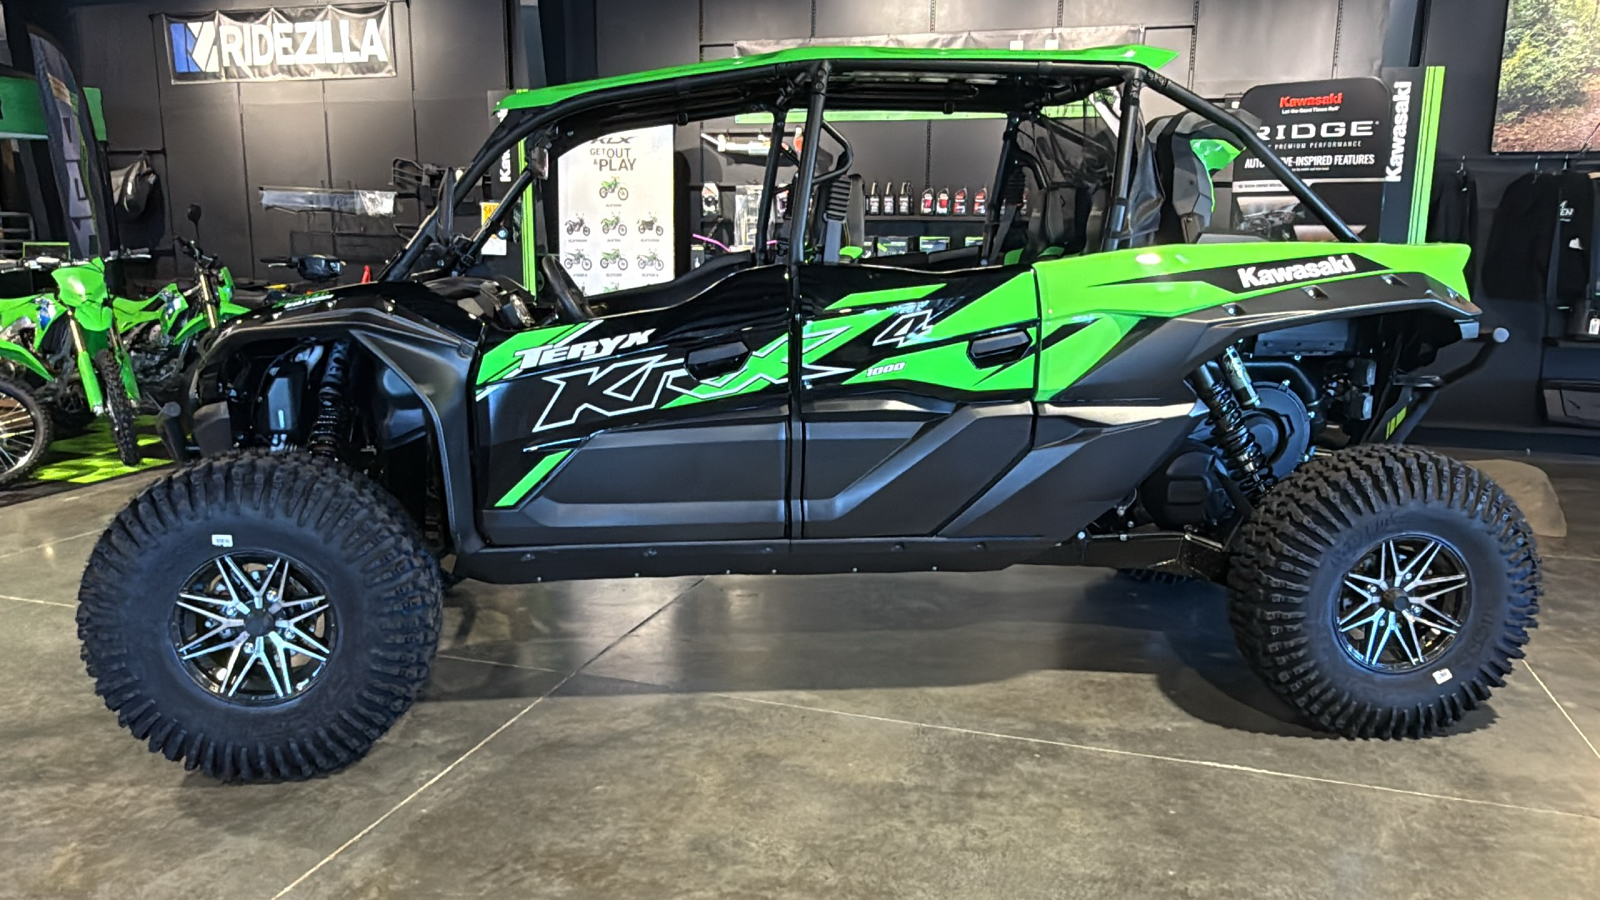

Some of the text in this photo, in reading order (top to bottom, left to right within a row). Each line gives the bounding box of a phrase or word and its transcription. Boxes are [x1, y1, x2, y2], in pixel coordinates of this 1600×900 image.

[219, 18, 389, 68] RIDEZILLA
[1280, 92, 1343, 108] Kawasaki
[1385, 81, 1412, 182] Kawasaki
[590, 148, 631, 159] GET OUT
[1274, 140, 1362, 150] PREMIUM PERFORMANCE
[599, 158, 637, 172] PLAY
[1333, 154, 1375, 166] FEATURES
[1237, 254, 1356, 289] Kawasaki
[872, 309, 933, 348] 4
[514, 328, 656, 370] TERYX
[866, 361, 906, 378] 1000
